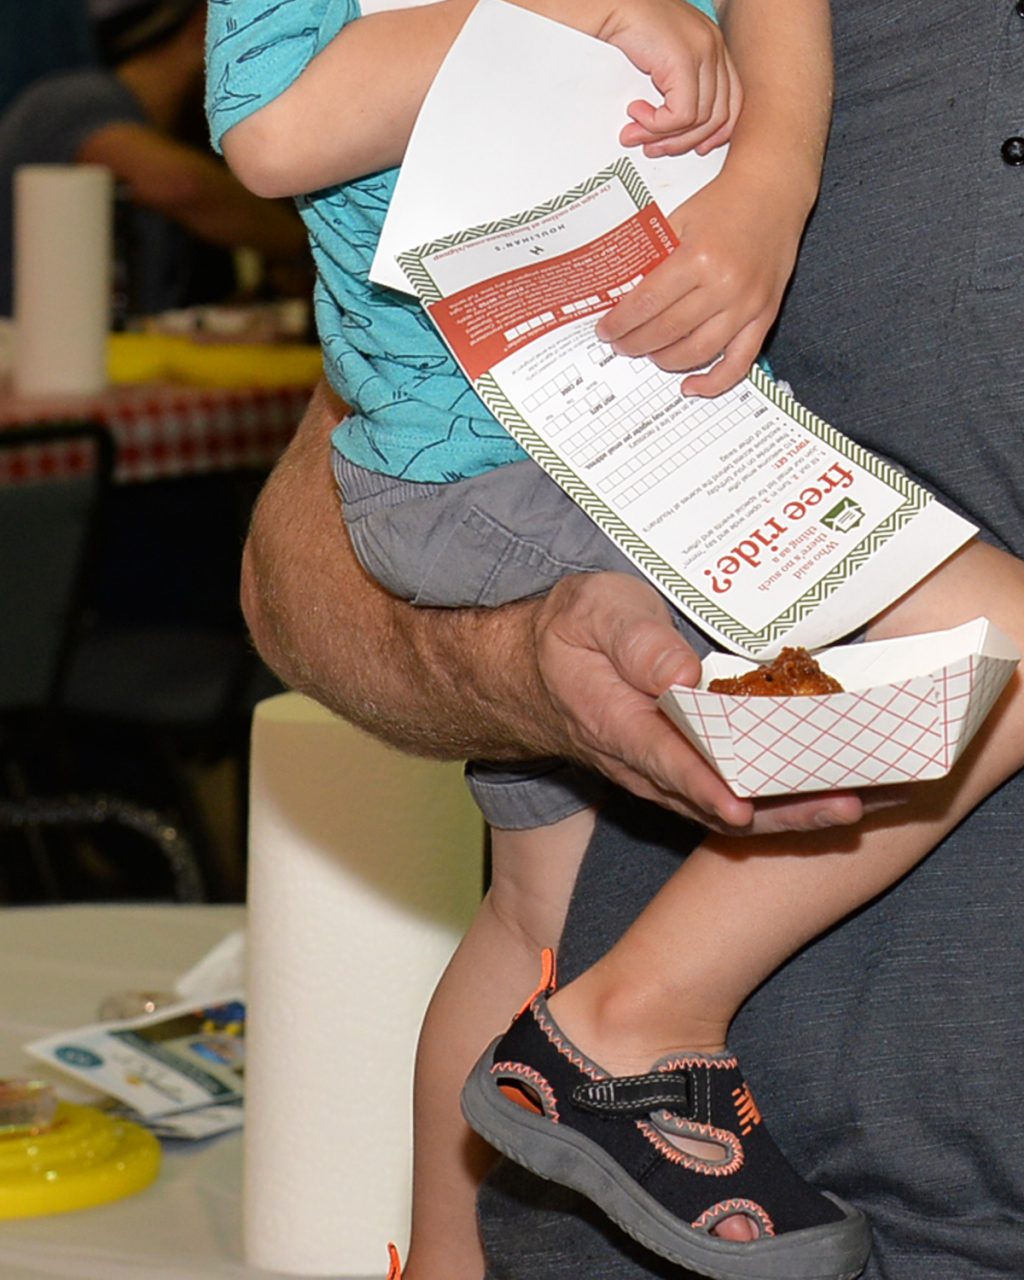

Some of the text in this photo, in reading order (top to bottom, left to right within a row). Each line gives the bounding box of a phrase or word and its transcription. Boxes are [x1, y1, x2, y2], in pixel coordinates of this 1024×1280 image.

[494, 224, 564, 251] HOULIHAN'S
[599, 351, 617, 366] ENDER
[739, 390, 751, 401] LAST
[705, 463, 852, 592] free ride?
[788, 526, 816, 548] thing
[757, 532, 827, 590] there's no such
[778, 547, 790, 557] as
[792, 541, 838, 579] Who said
